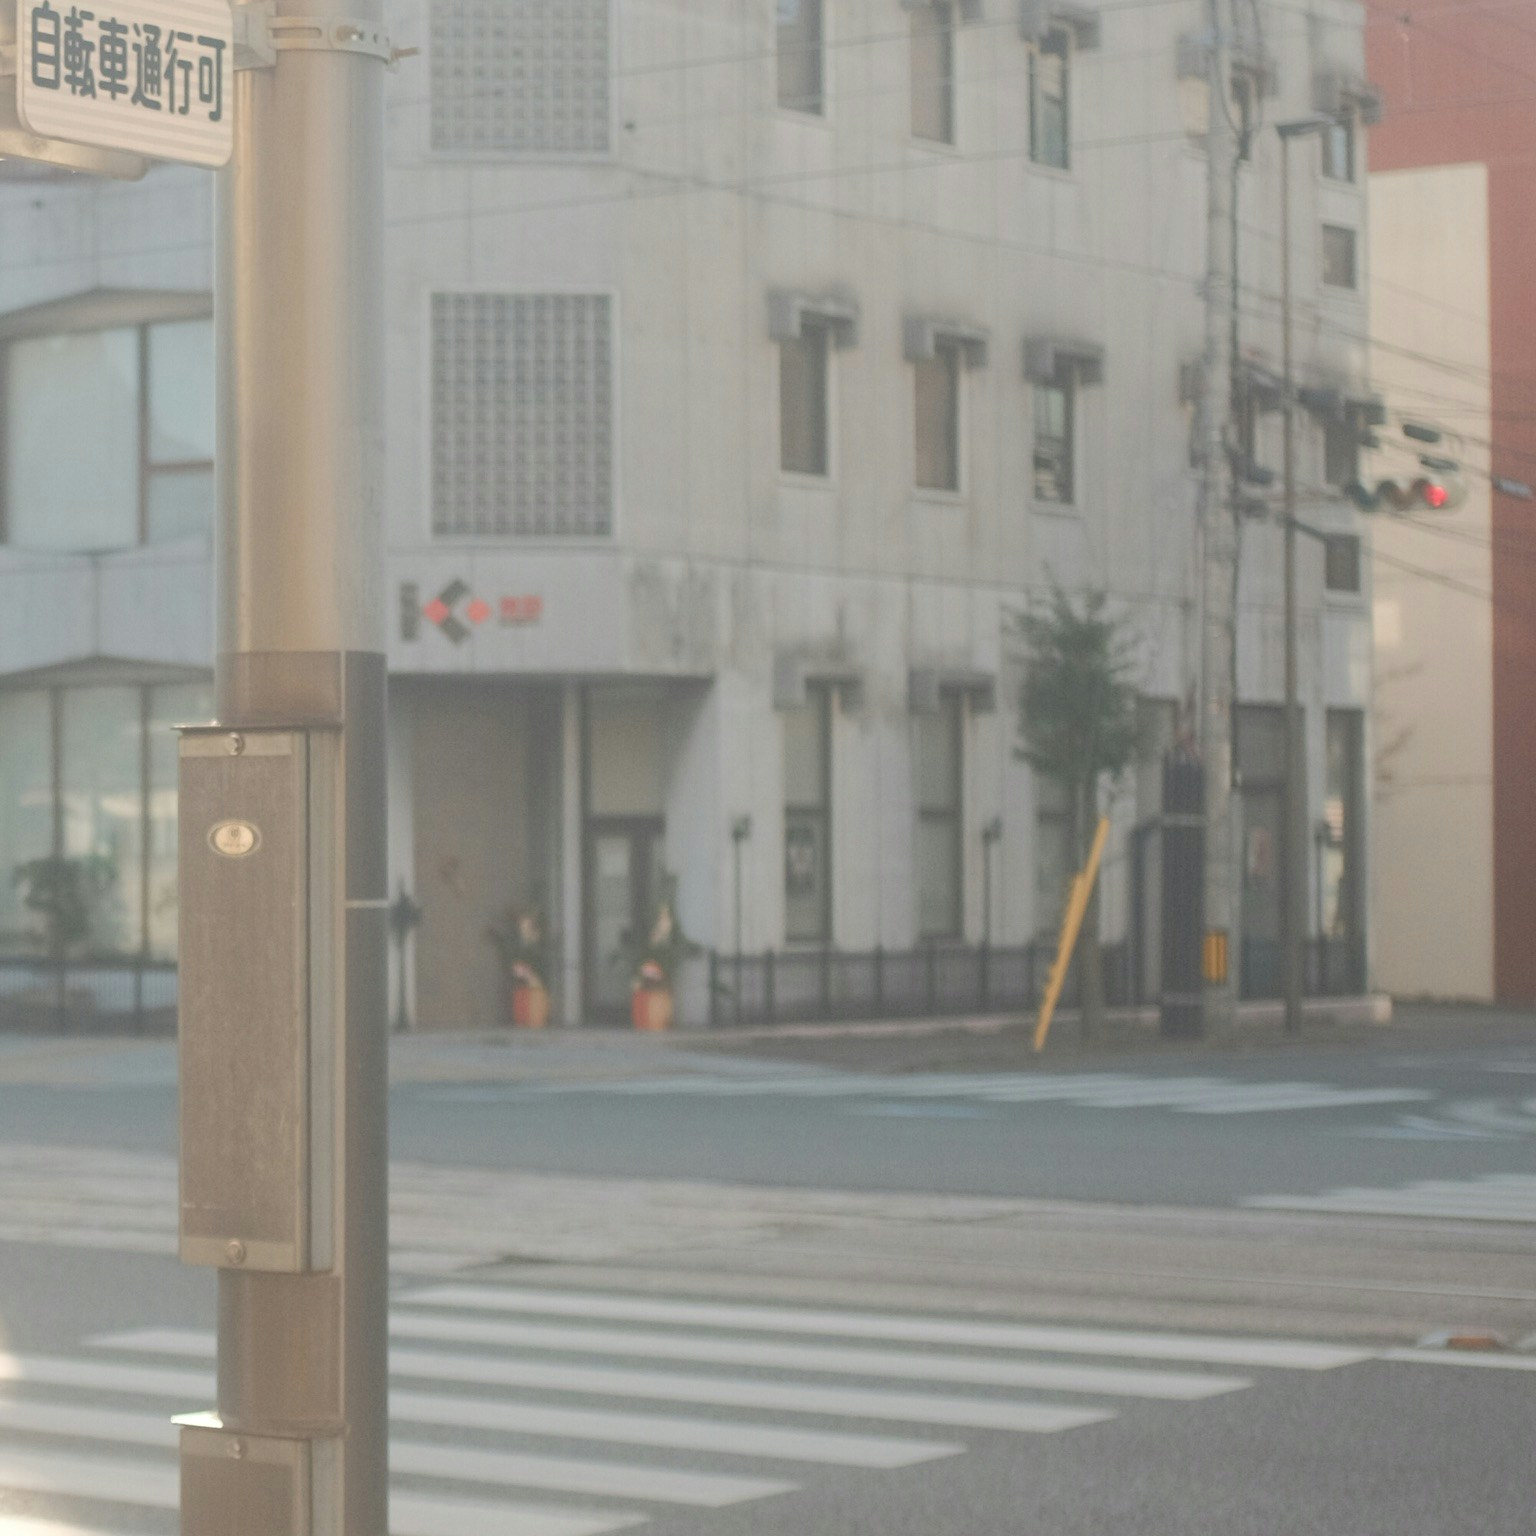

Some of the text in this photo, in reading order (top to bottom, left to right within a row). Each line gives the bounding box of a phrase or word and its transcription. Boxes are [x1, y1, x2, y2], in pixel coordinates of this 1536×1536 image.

[32, 0, 226, 122] 自転車通行可
